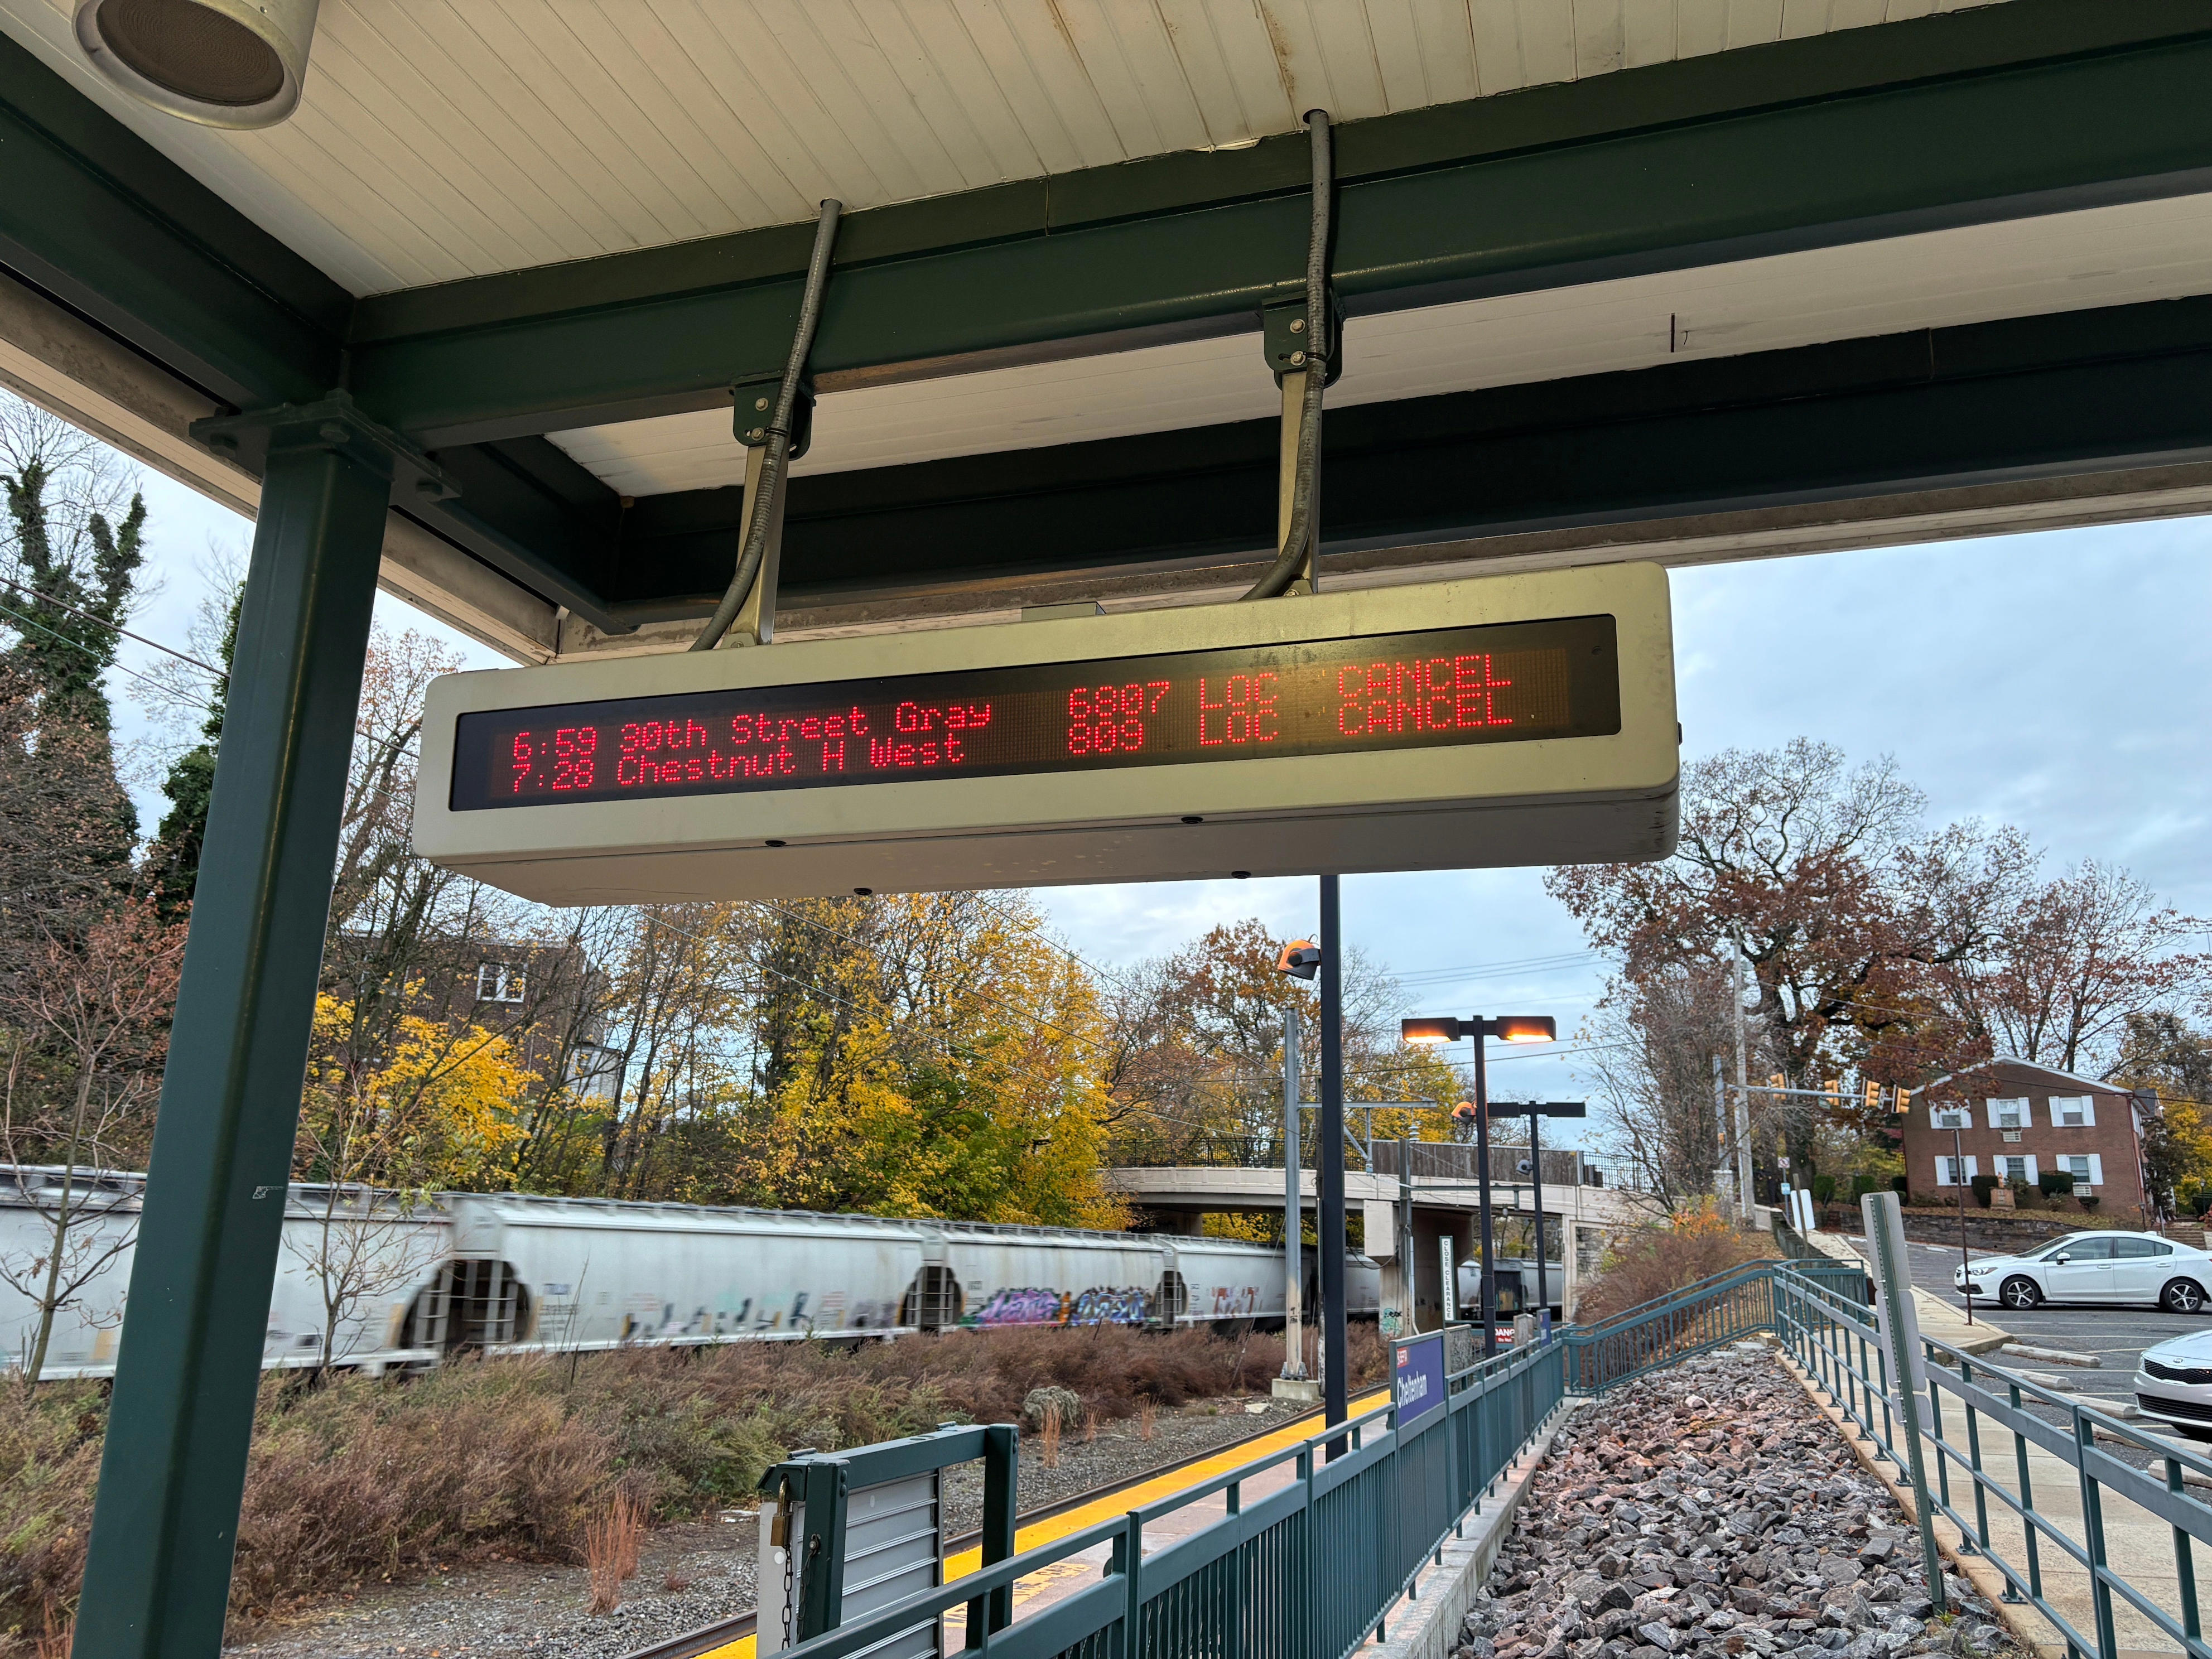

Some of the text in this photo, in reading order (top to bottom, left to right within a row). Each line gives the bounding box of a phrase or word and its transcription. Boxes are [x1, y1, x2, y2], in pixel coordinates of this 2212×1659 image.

[513, 654, 1513, 760] 6:59 30th Street Gray 6807 LOC CANCEL
[512, 692, 1513, 792] 7:28 Chestnut H West 809 LOC CANCEL
[1495, 1328, 1515, 1337] DANG
[1397, 1371, 1428, 1409] Cheltenham
